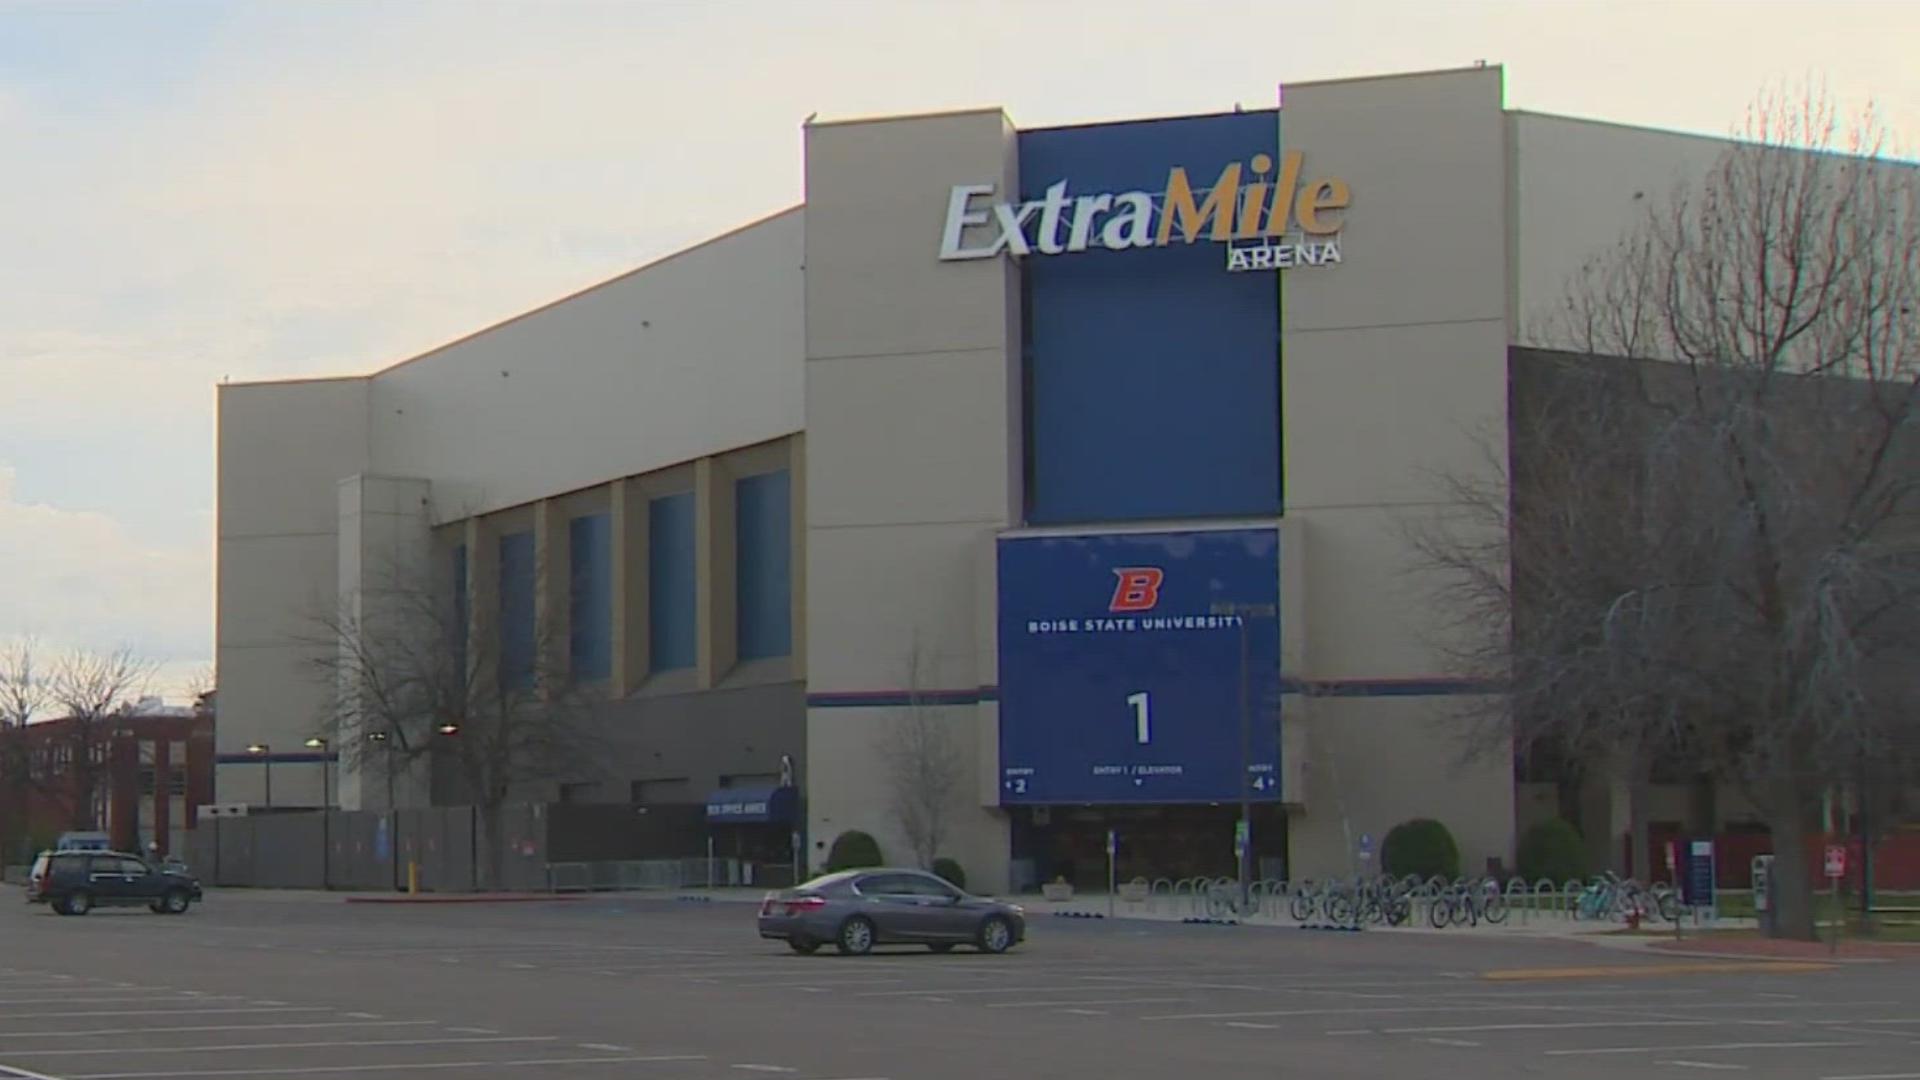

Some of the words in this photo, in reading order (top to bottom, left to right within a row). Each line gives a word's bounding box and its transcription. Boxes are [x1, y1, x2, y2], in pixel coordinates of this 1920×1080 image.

[940, 151, 1350, 260] ExtraMile
[1227, 241, 1341, 271] ARENA
[1109, 567, 1163, 611] B
[1028, 619, 1078, 633] BOISE
[1085, 618, 1136, 632] STATE
[1127, 692, 1149, 744] 1
[1015, 778, 1026, 793] 2
[1252, 776, 1265, 790] 4
